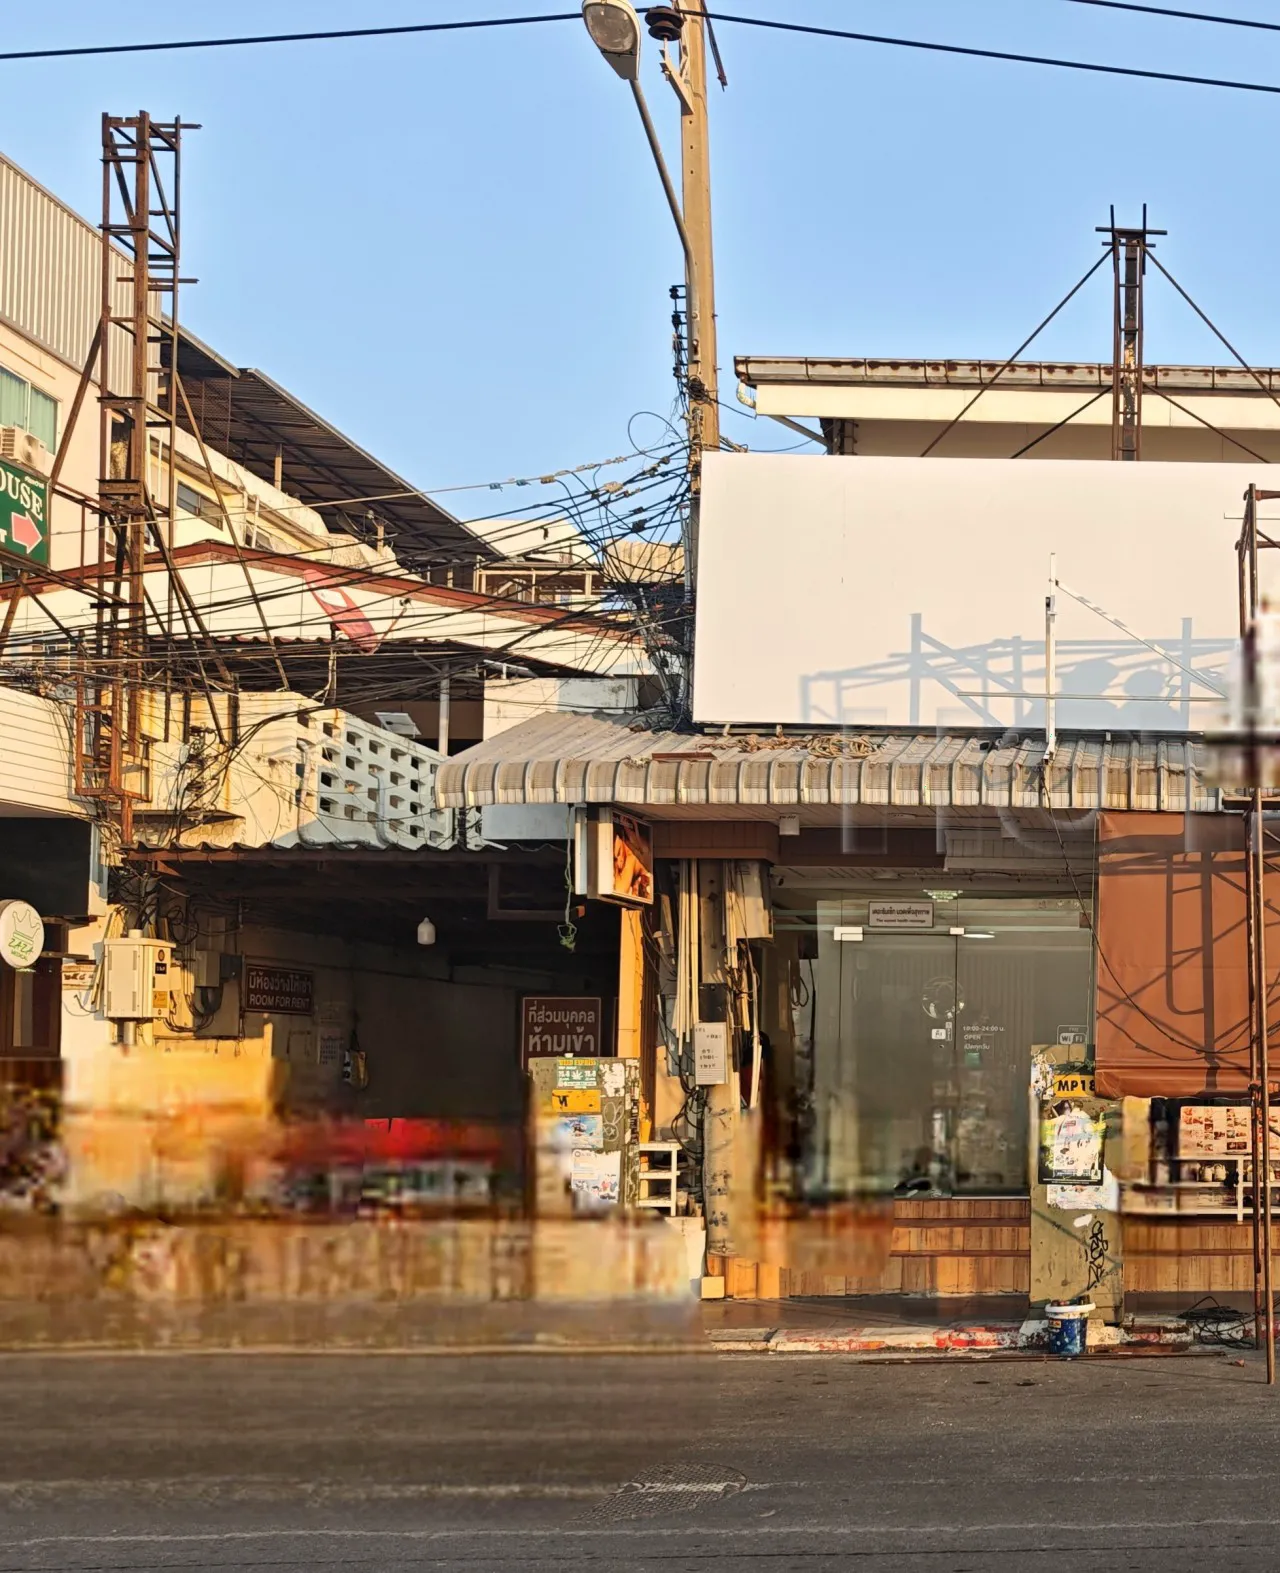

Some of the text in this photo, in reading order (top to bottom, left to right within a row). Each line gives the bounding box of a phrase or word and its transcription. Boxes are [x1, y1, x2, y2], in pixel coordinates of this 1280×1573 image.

[249, 993, 310, 1009] ROOM FOR RENT
[528, 1000, 595, 1028] ที่ส่วนบุคคล
[528, 1026, 595, 1052] ห้ามเข้า
